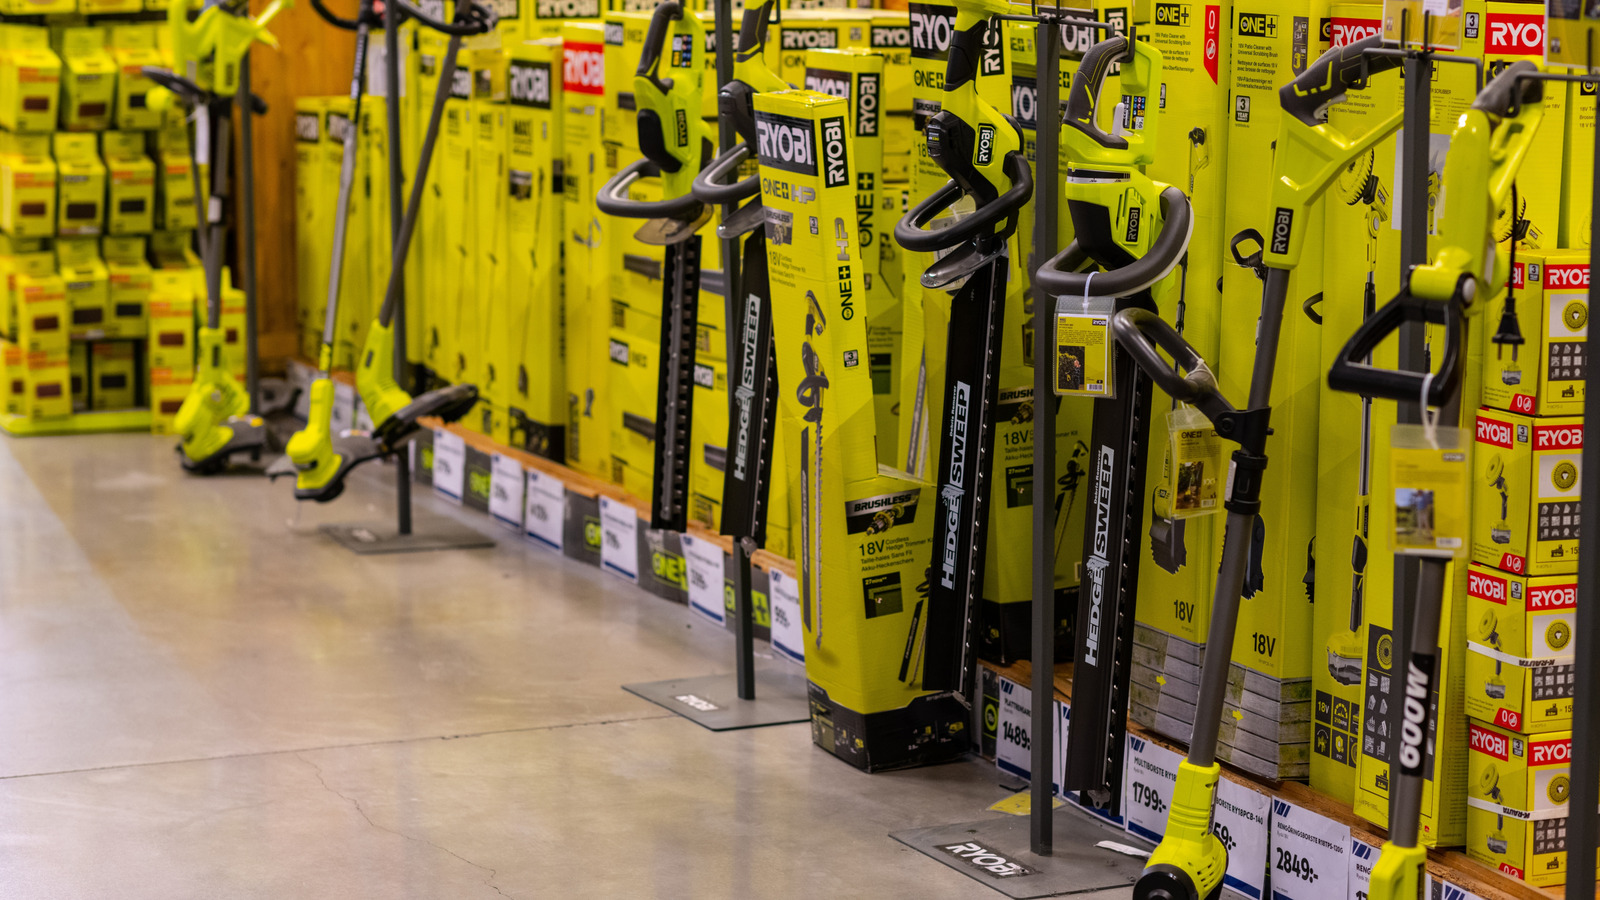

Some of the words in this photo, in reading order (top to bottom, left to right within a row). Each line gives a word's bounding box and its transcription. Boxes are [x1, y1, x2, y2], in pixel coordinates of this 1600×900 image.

[911, 12, 957, 52] RYO
[1469, 15, 1475, 26] 3
[783, 30, 836, 48] RYOBI
[872, 28, 910, 46] RYO
[1490, 22, 1545, 47] RYO
[564, 50, 605, 87] RYOBI
[510, 65, 549, 103] RYOBI
[859, 76, 877, 134] RYOBI
[1240, 99, 1246, 110] 3
[757, 121, 815, 166] RYOBI
[825, 119, 845, 185] RYOBI
[978, 129, 991, 162] RYOBI
[791, 184, 816, 204] HP
[1128, 209, 1139, 240] RYOBI
[1273, 211, 1291, 252] RYOBI
[1549, 269, 1590, 286] RYOB
[743, 300, 757, 388] SWEEP
[848, 352, 853, 360] 3
[1000, 388, 1035, 400] BRUSH
[734, 394, 751, 481] HEDGE
[1003, 430, 1028, 445] 18V
[1477, 420, 1512, 445] RYOBI
[1538, 428, 1583, 447] RYOB
[941, 495, 960, 590] HEDGE
[952, 387, 969, 485] SWEEP
[854, 493, 912, 513] BRUSHLESS
[859, 540, 885, 557] 18V
[1085, 567, 1104, 667] HEDGE
[1095, 452, 1113, 555] SWEEP
[1469, 575, 1506, 601] RYOBI
[1174, 599, 1195, 623] 18V
[1252, 632, 1276, 657] 18V
[1400, 660, 1429, 769] 600W
[1003, 720, 1031, 751] 1489:
[1471, 729, 1507, 757] RYOBI
[1134, 756, 1164, 777] MULTIBORSTE
[1132, 781, 1167, 813] 1799:-
[945, 842, 1030, 876] RYOBI
[1276, 847, 1319, 884] 2849:-
[1356, 863, 1371, 875] RENG
